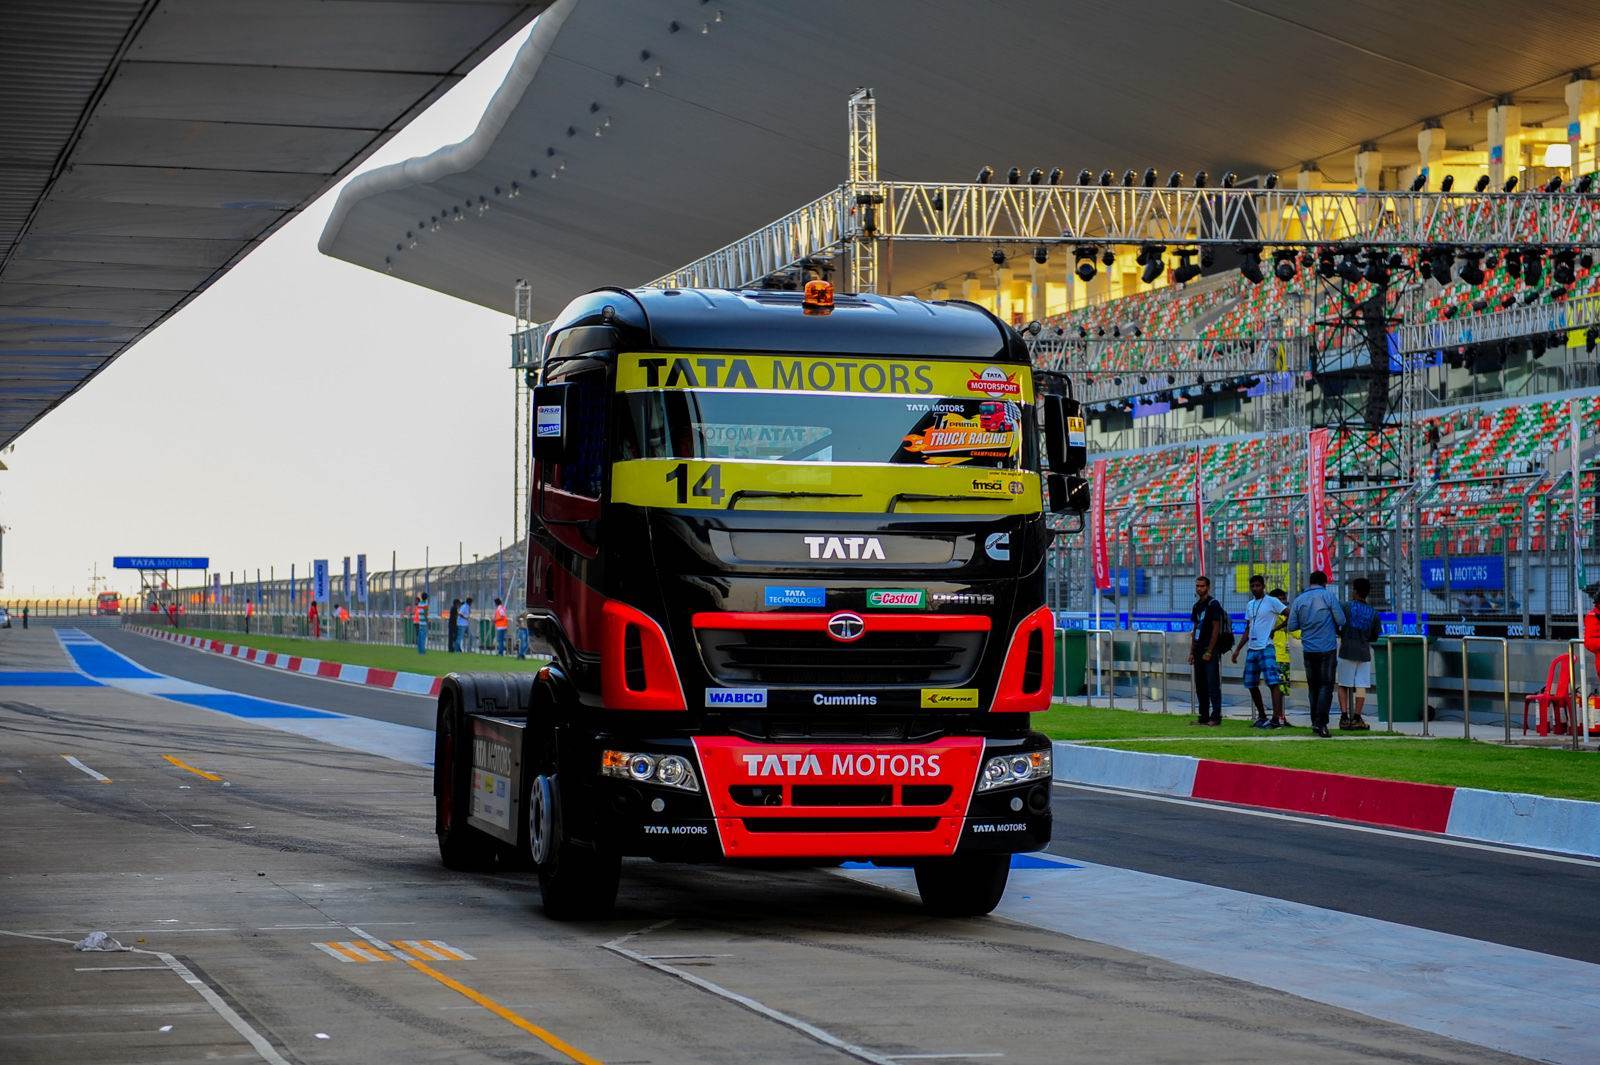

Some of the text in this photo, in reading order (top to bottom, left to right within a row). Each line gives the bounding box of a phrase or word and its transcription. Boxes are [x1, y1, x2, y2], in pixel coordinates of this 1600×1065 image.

[638, 358, 934, 394] TATA MOTORS
[971, 382, 1017, 391] MOTORSPORT
[932, 404, 965, 412] MOTORS
[930, 431, 1007, 446] TRUCK RACING
[666, 463, 726, 505] 14
[804, 536, 886, 560] TATA
[130, 559, 193, 567] TATA MOTORS
[1454, 565, 1488, 581] MOTORS
[769, 596, 821, 604] TECHNOLOGIES
[882, 593, 918, 605] Castrol
[1445, 624, 1476, 636] accenture
[709, 693, 764, 703] WABCO
[813, 694, 878, 706] Cummins
[743, 754, 941, 777] TATA MOTORS
[643, 825, 708, 834] TATA MOTORS
[972, 823, 1027, 833] TATA MOTORS
